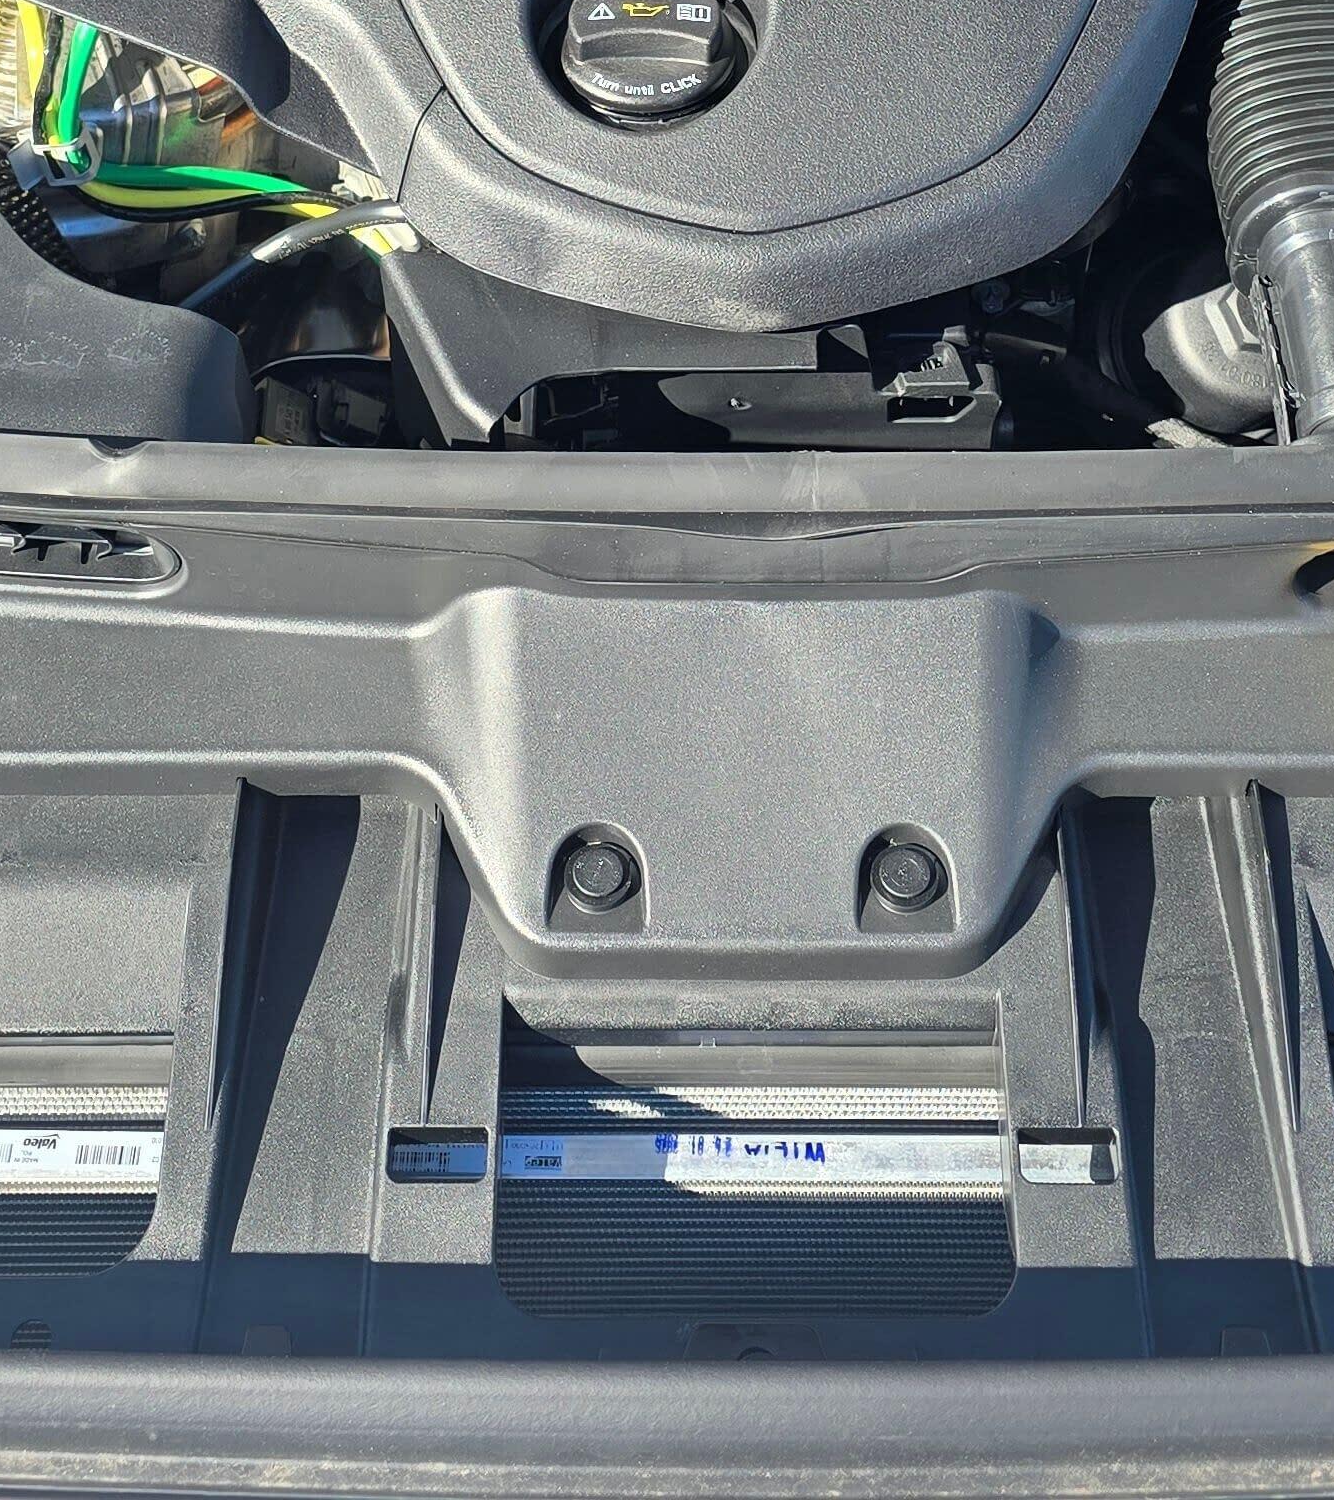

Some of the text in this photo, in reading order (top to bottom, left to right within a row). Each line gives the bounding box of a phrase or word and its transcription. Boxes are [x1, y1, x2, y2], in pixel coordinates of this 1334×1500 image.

[590, 72, 703, 97] Turn until CLICK
[23, 1137, 57, 1150] Valeo
